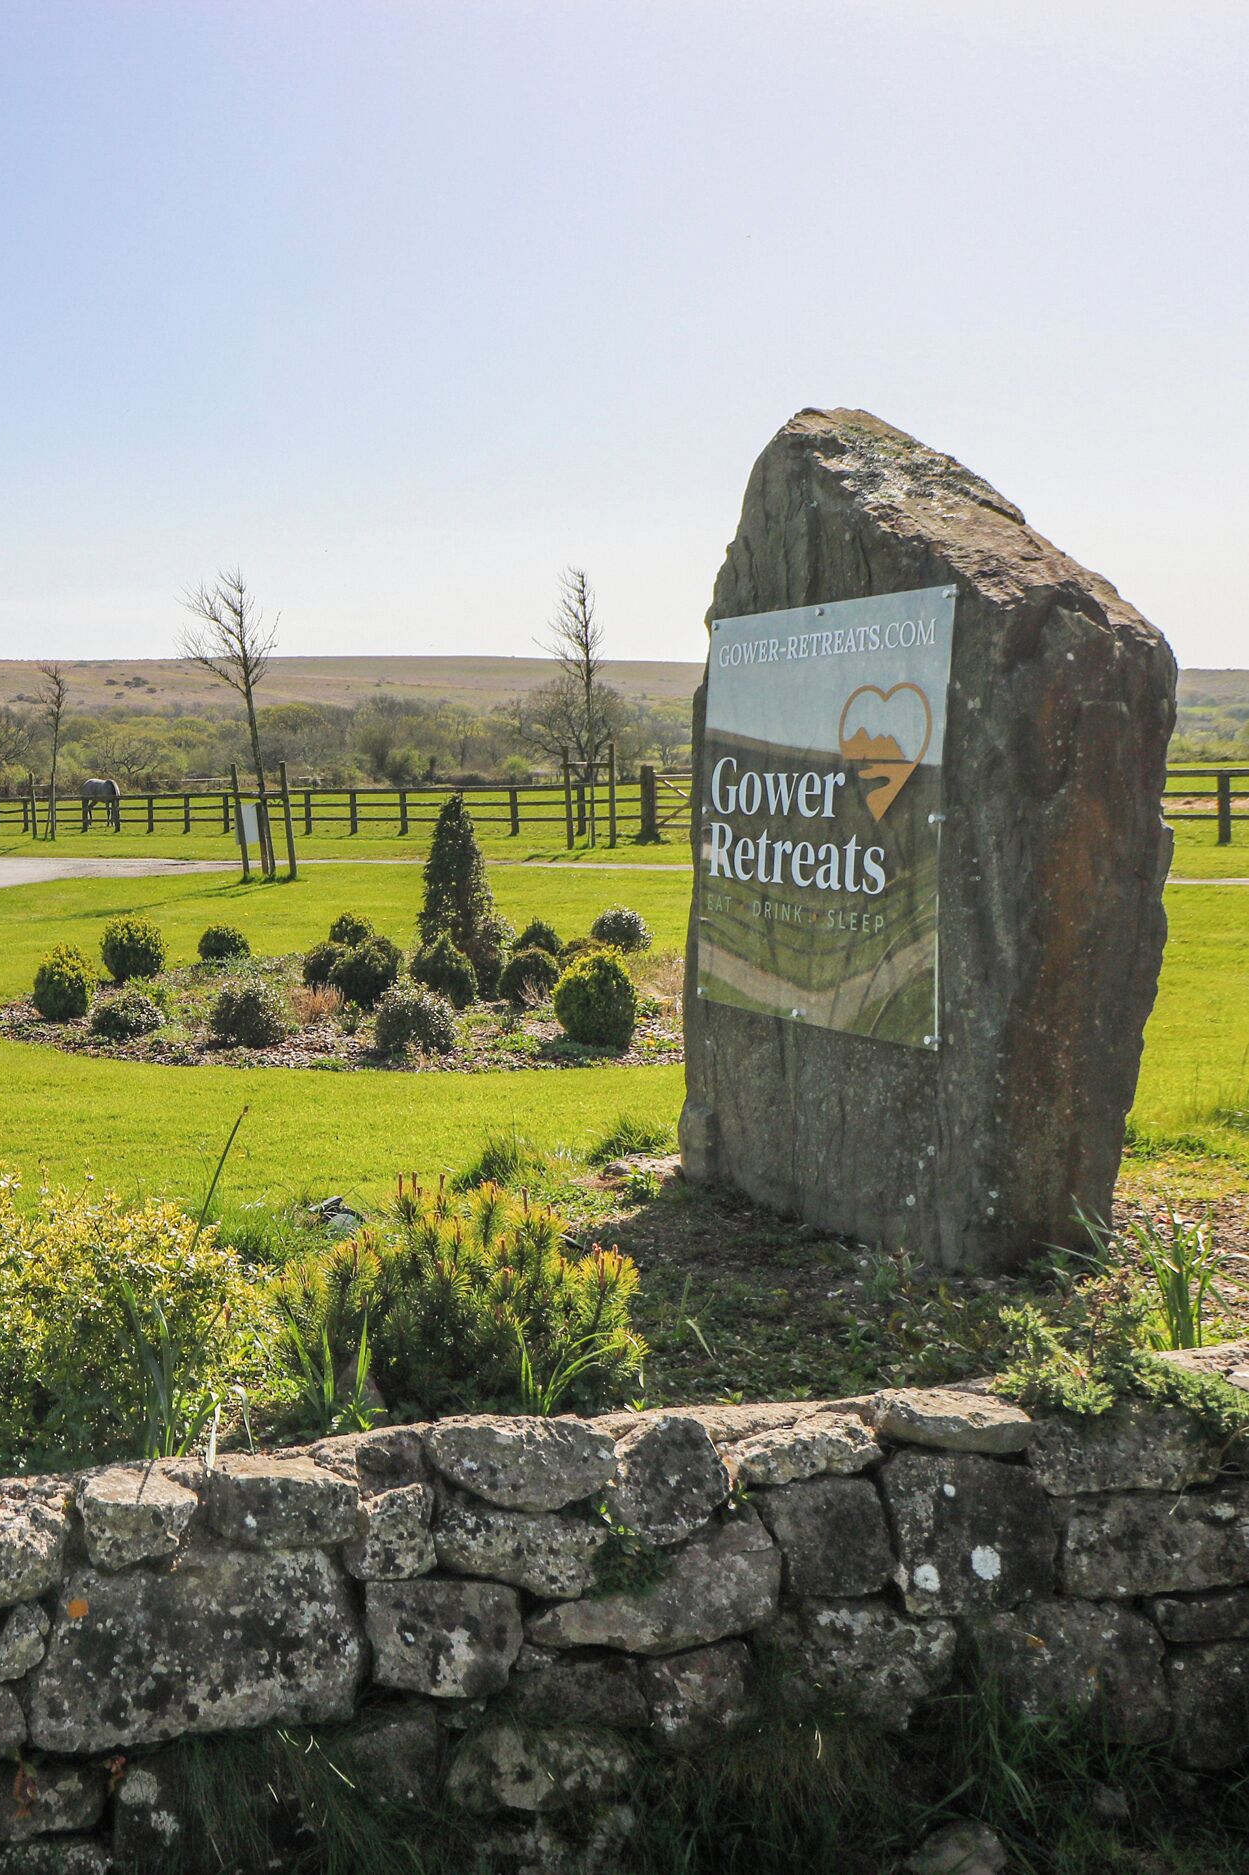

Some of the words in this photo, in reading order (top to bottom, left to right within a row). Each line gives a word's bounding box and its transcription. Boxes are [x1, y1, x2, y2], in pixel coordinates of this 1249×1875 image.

[718, 617, 937, 668] GOWER-RETREATS.COM
[711, 756, 846, 818] Gower
[708, 822, 887, 895] Retreats
[707, 894, 732, 913] EAT
[752, 900, 803, 923] DRINK
[827, 909, 885, 934] SLEEP
